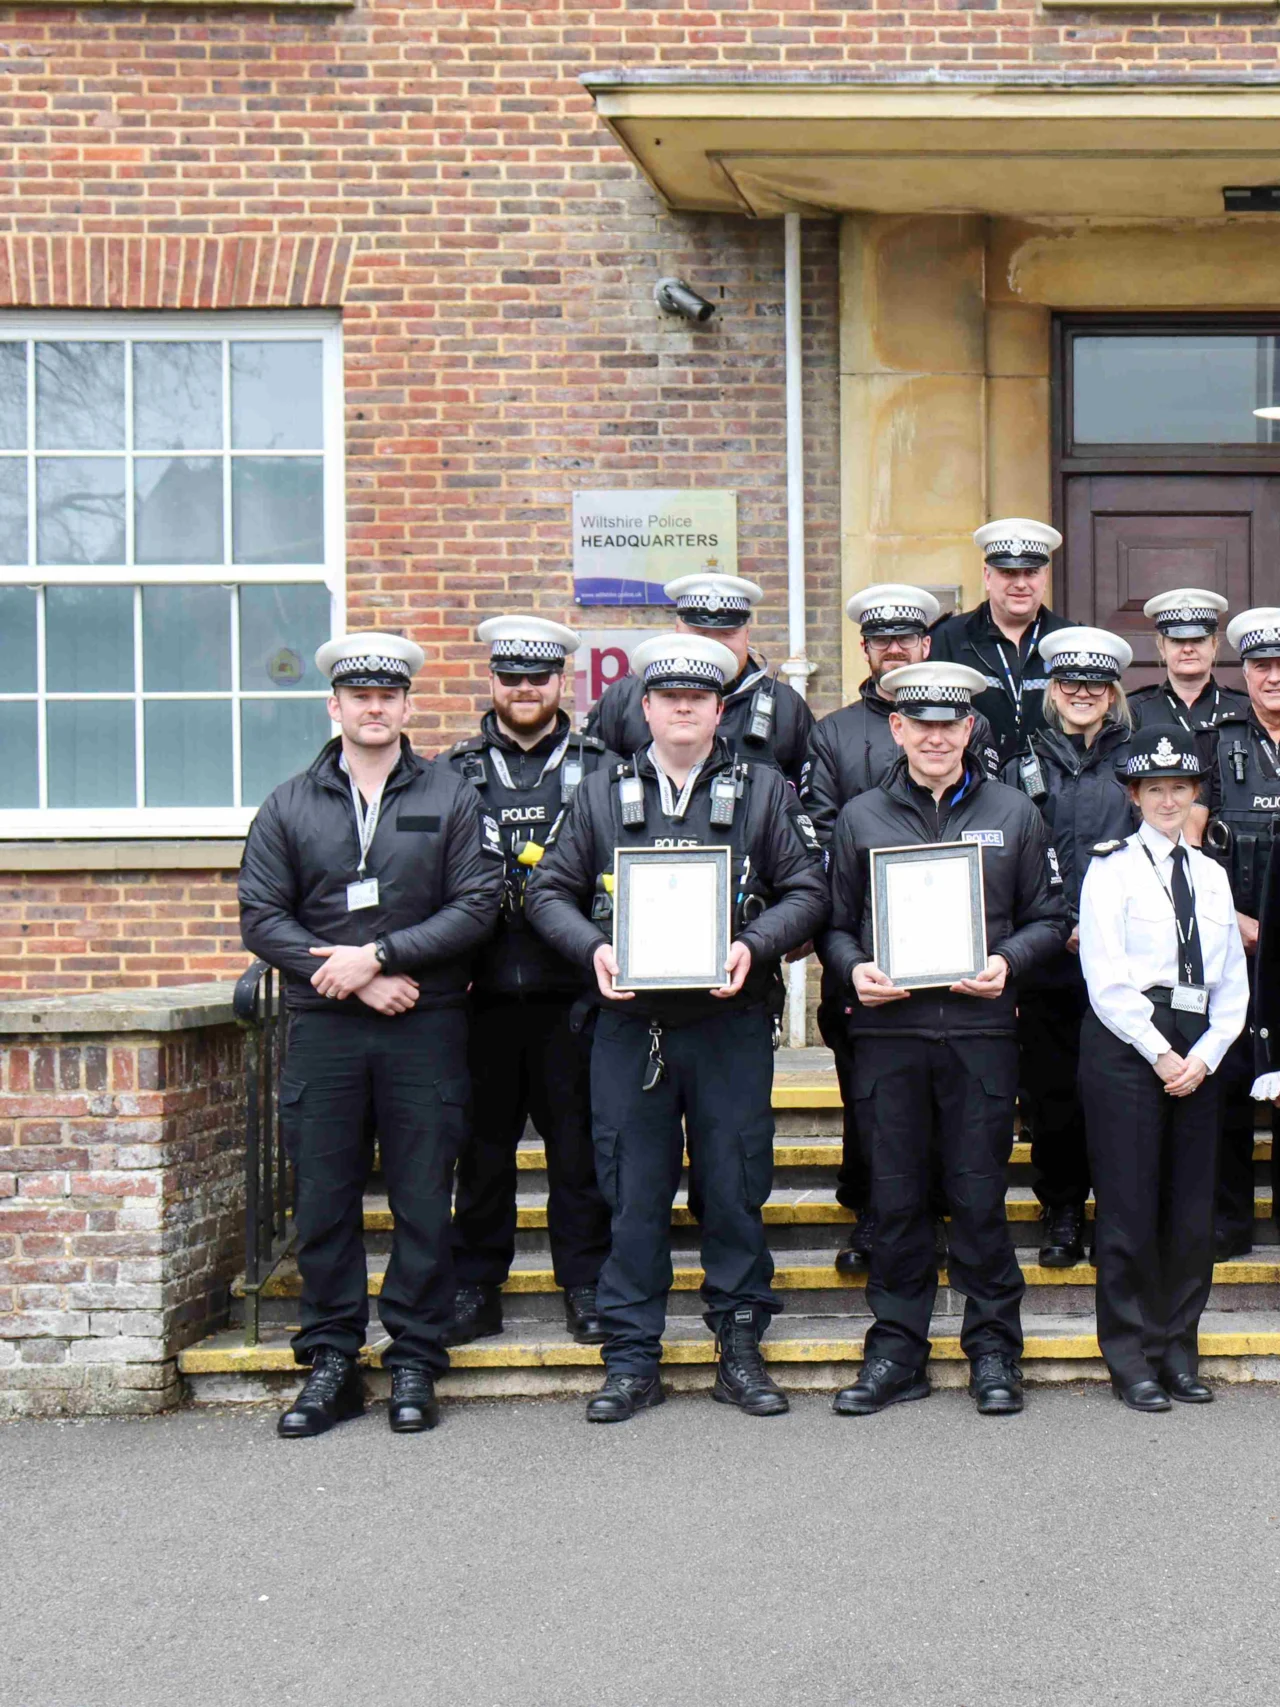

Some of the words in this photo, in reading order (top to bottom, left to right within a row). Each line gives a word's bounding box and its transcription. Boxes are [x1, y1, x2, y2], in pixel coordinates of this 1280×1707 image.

[581, 515, 643, 528] Wiltshire
[648, 514, 692, 528] Police
[581, 534, 719, 547] HEADQUARTERS
[501, 807, 545, 821] POLICE
[655, 838, 698, 848] POLICE
[966, 833, 1000, 843] POLICE
